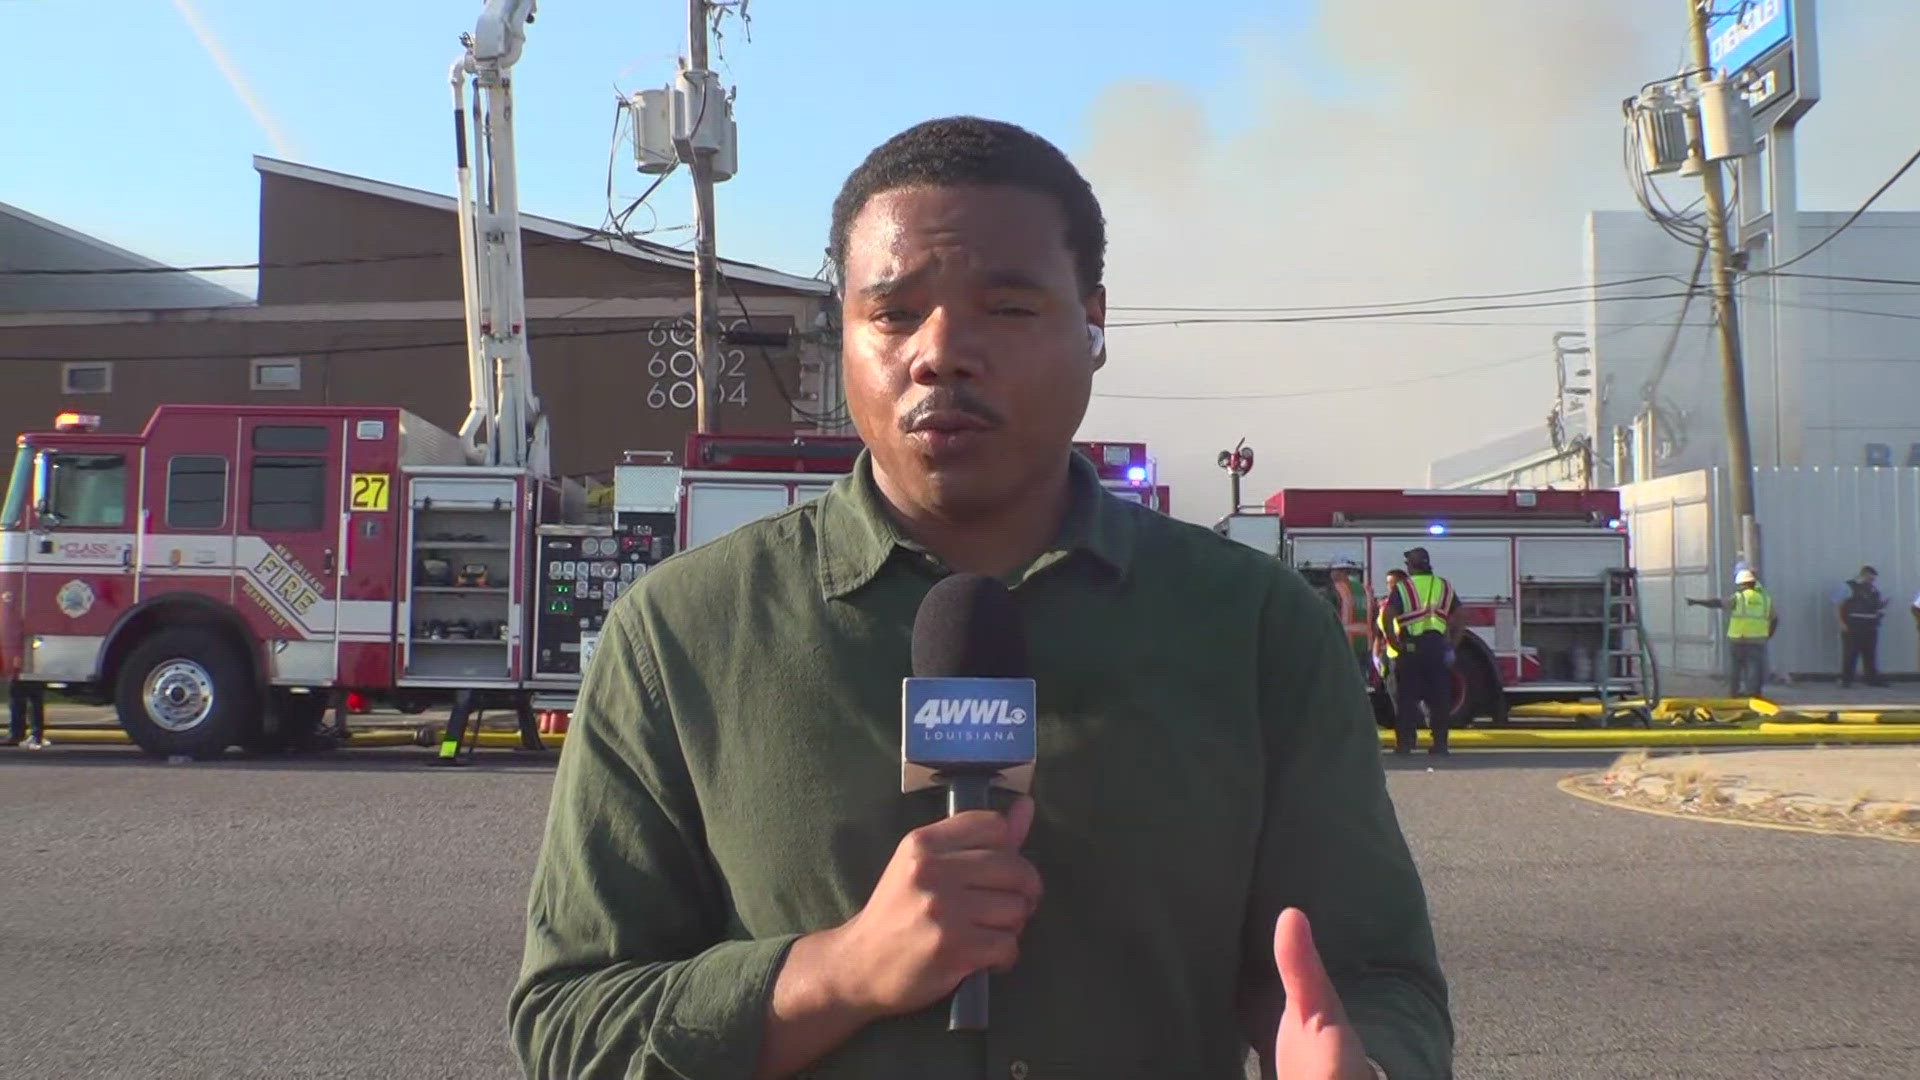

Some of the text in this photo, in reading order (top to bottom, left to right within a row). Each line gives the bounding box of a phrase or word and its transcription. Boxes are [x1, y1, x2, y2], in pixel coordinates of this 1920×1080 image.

[648, 350, 746, 378] 602
[647, 381, 748, 408] 604
[353, 477, 386, 508] 27
[254, 551, 318, 615] FIRE
[924, 731, 1015, 741] LOUISIANA
